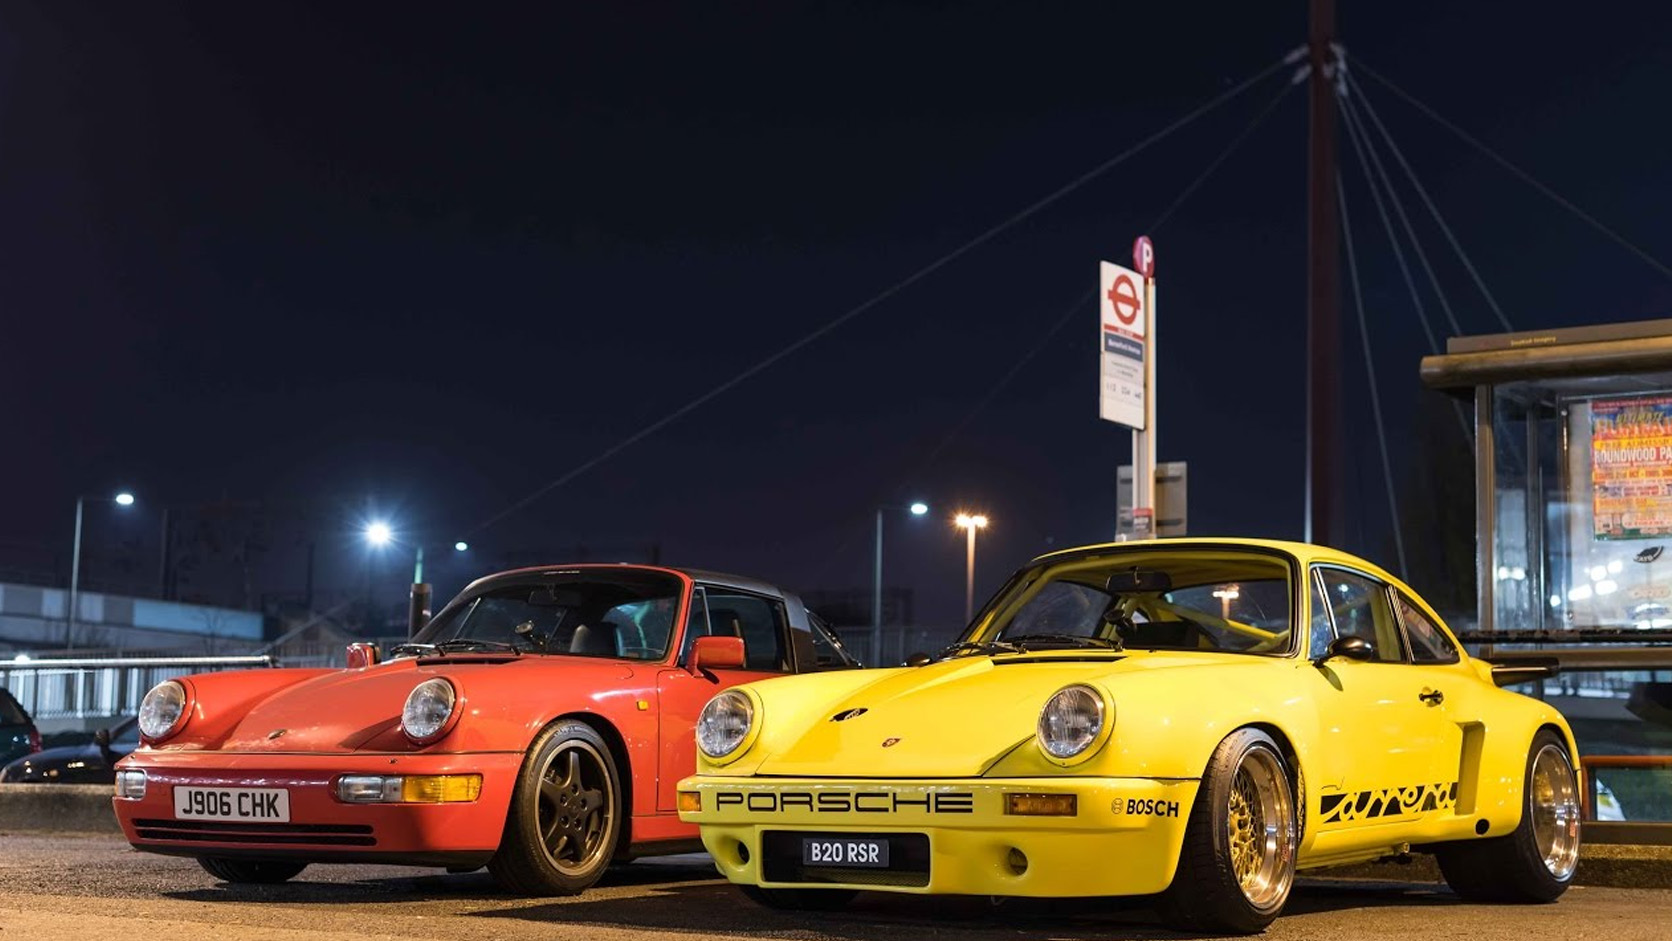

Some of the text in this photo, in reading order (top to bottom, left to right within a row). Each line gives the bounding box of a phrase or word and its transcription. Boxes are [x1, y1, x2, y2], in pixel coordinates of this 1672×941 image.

[1142, 242, 1153, 273] P
[1594, 447, 1656, 464] ROUNDWOOD
[182, 790, 280, 818] J906 CHK
[716, 792, 973, 814] PORSCHE
[1126, 799, 1179, 818] BOSCH
[811, 842, 879, 863] B20 RSR
